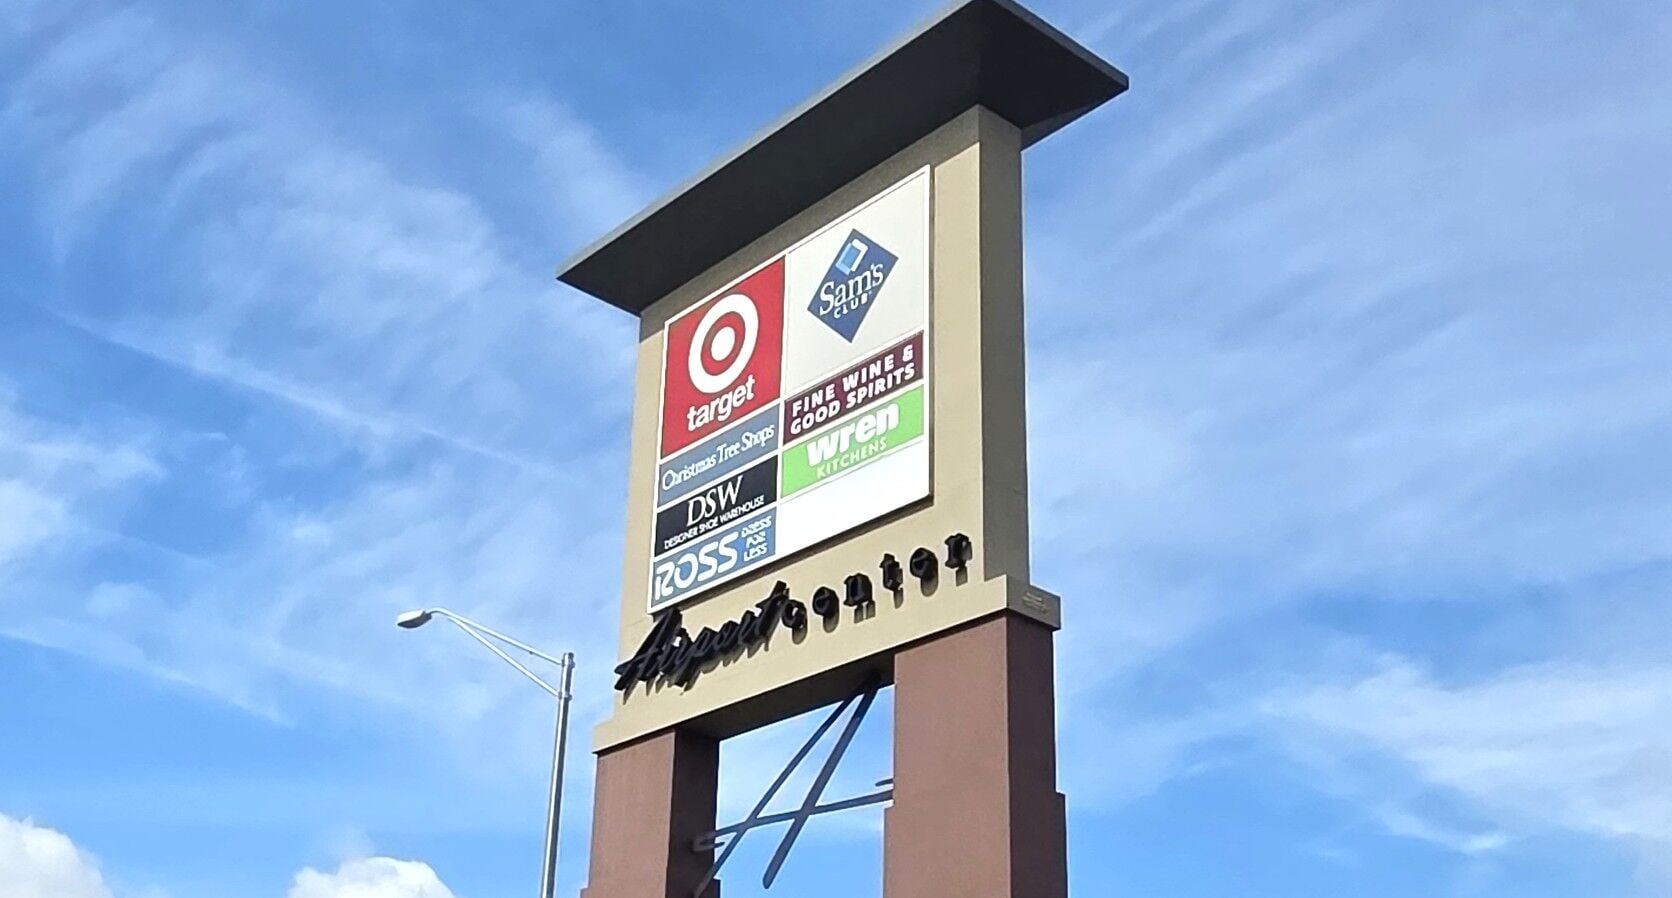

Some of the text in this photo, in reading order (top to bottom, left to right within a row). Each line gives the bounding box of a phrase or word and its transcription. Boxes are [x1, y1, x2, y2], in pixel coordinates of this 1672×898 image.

[820, 263, 883, 316] Sam's
[834, 292, 868, 319] CLUB
[687, 374, 755, 431] target
[790, 362, 915, 435] GOOD SPIRITS
[792, 344, 913, 417] FINE WINE &
[662, 424, 775, 491] Christmas Tree Shops
[806, 403, 900, 467] wren
[816, 437, 887, 479] KITCHENS
[664, 494, 765, 550] DESIGNER SHOE WAREHOUSE
[687, 475, 743, 528] DSW
[741, 515, 772, 538] DRESS
[654, 531, 739, 600] ROSS
[744, 542, 768, 561] LESS
